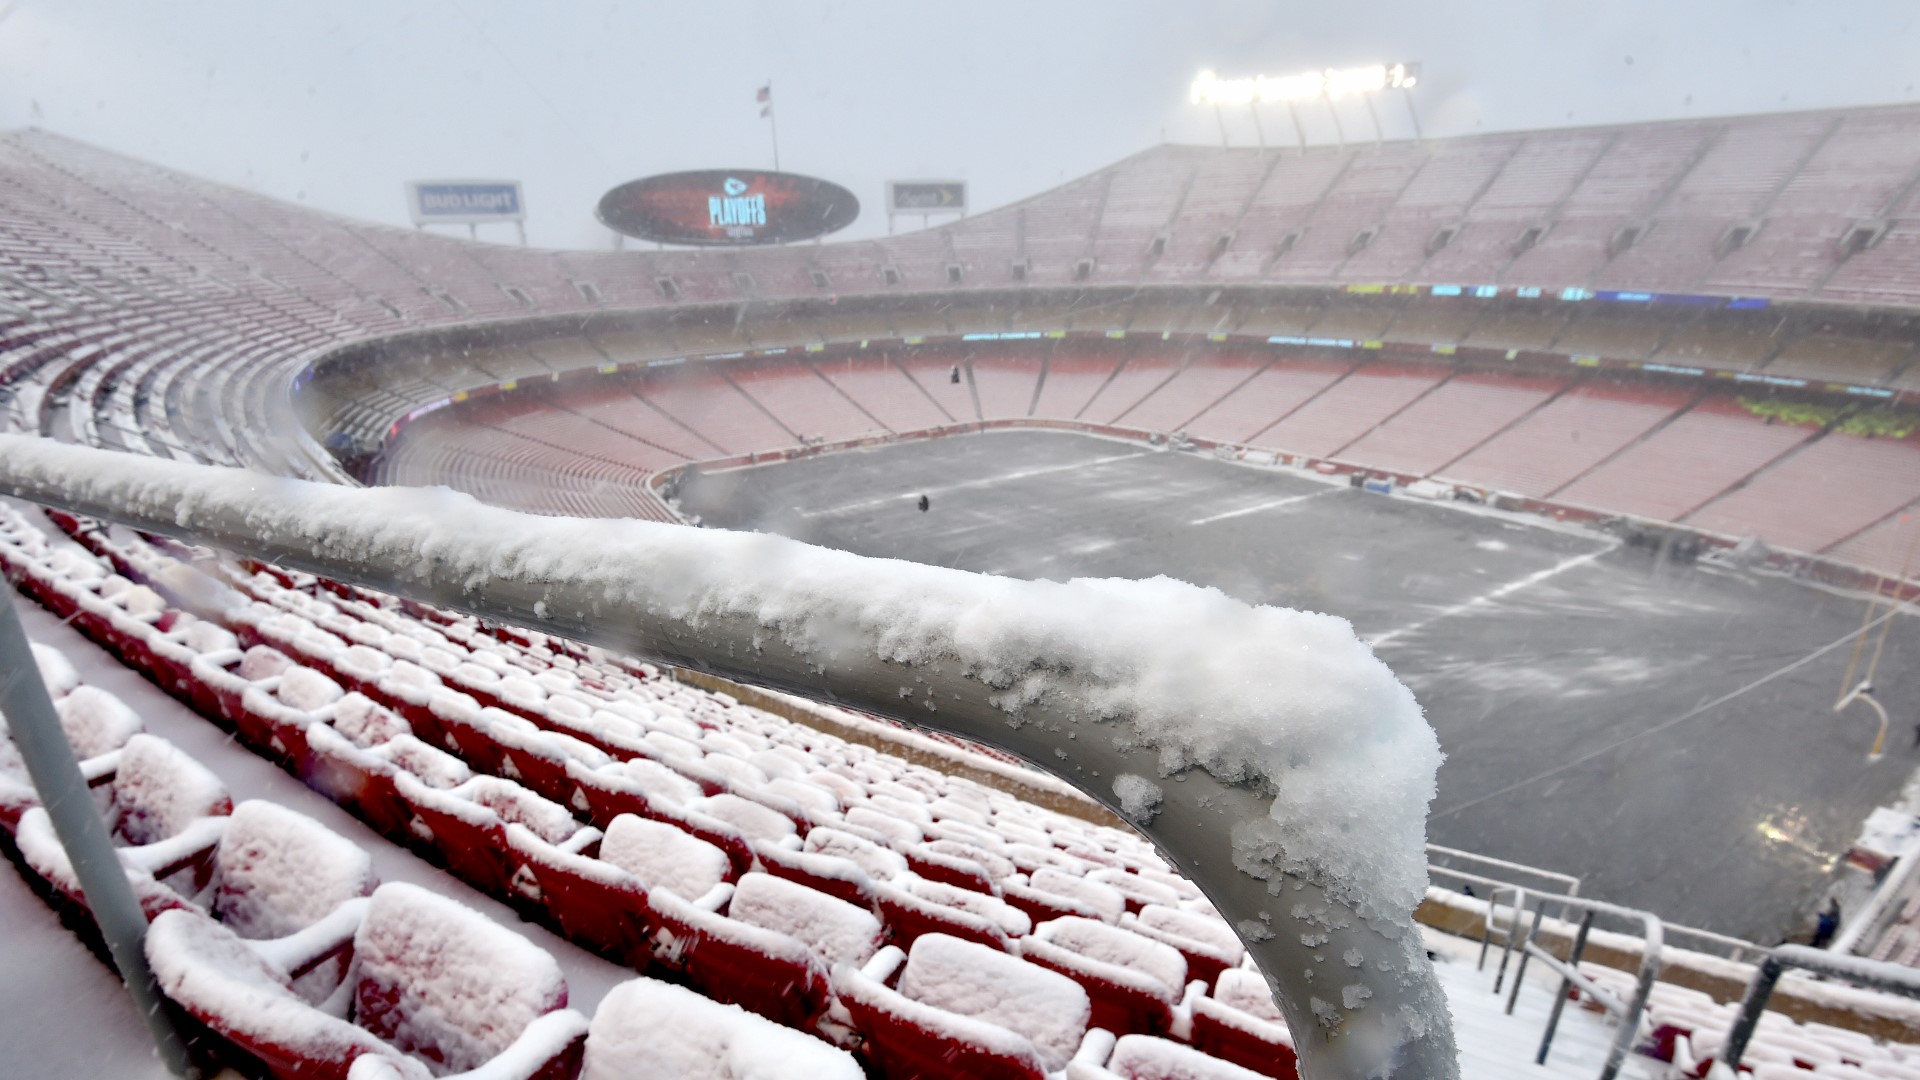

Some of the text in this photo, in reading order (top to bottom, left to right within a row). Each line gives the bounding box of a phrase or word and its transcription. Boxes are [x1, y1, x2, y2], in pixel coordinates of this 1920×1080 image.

[424, 192, 513, 209] BUD LIGHT
[708, 195, 766, 226] PLAYOFFS
